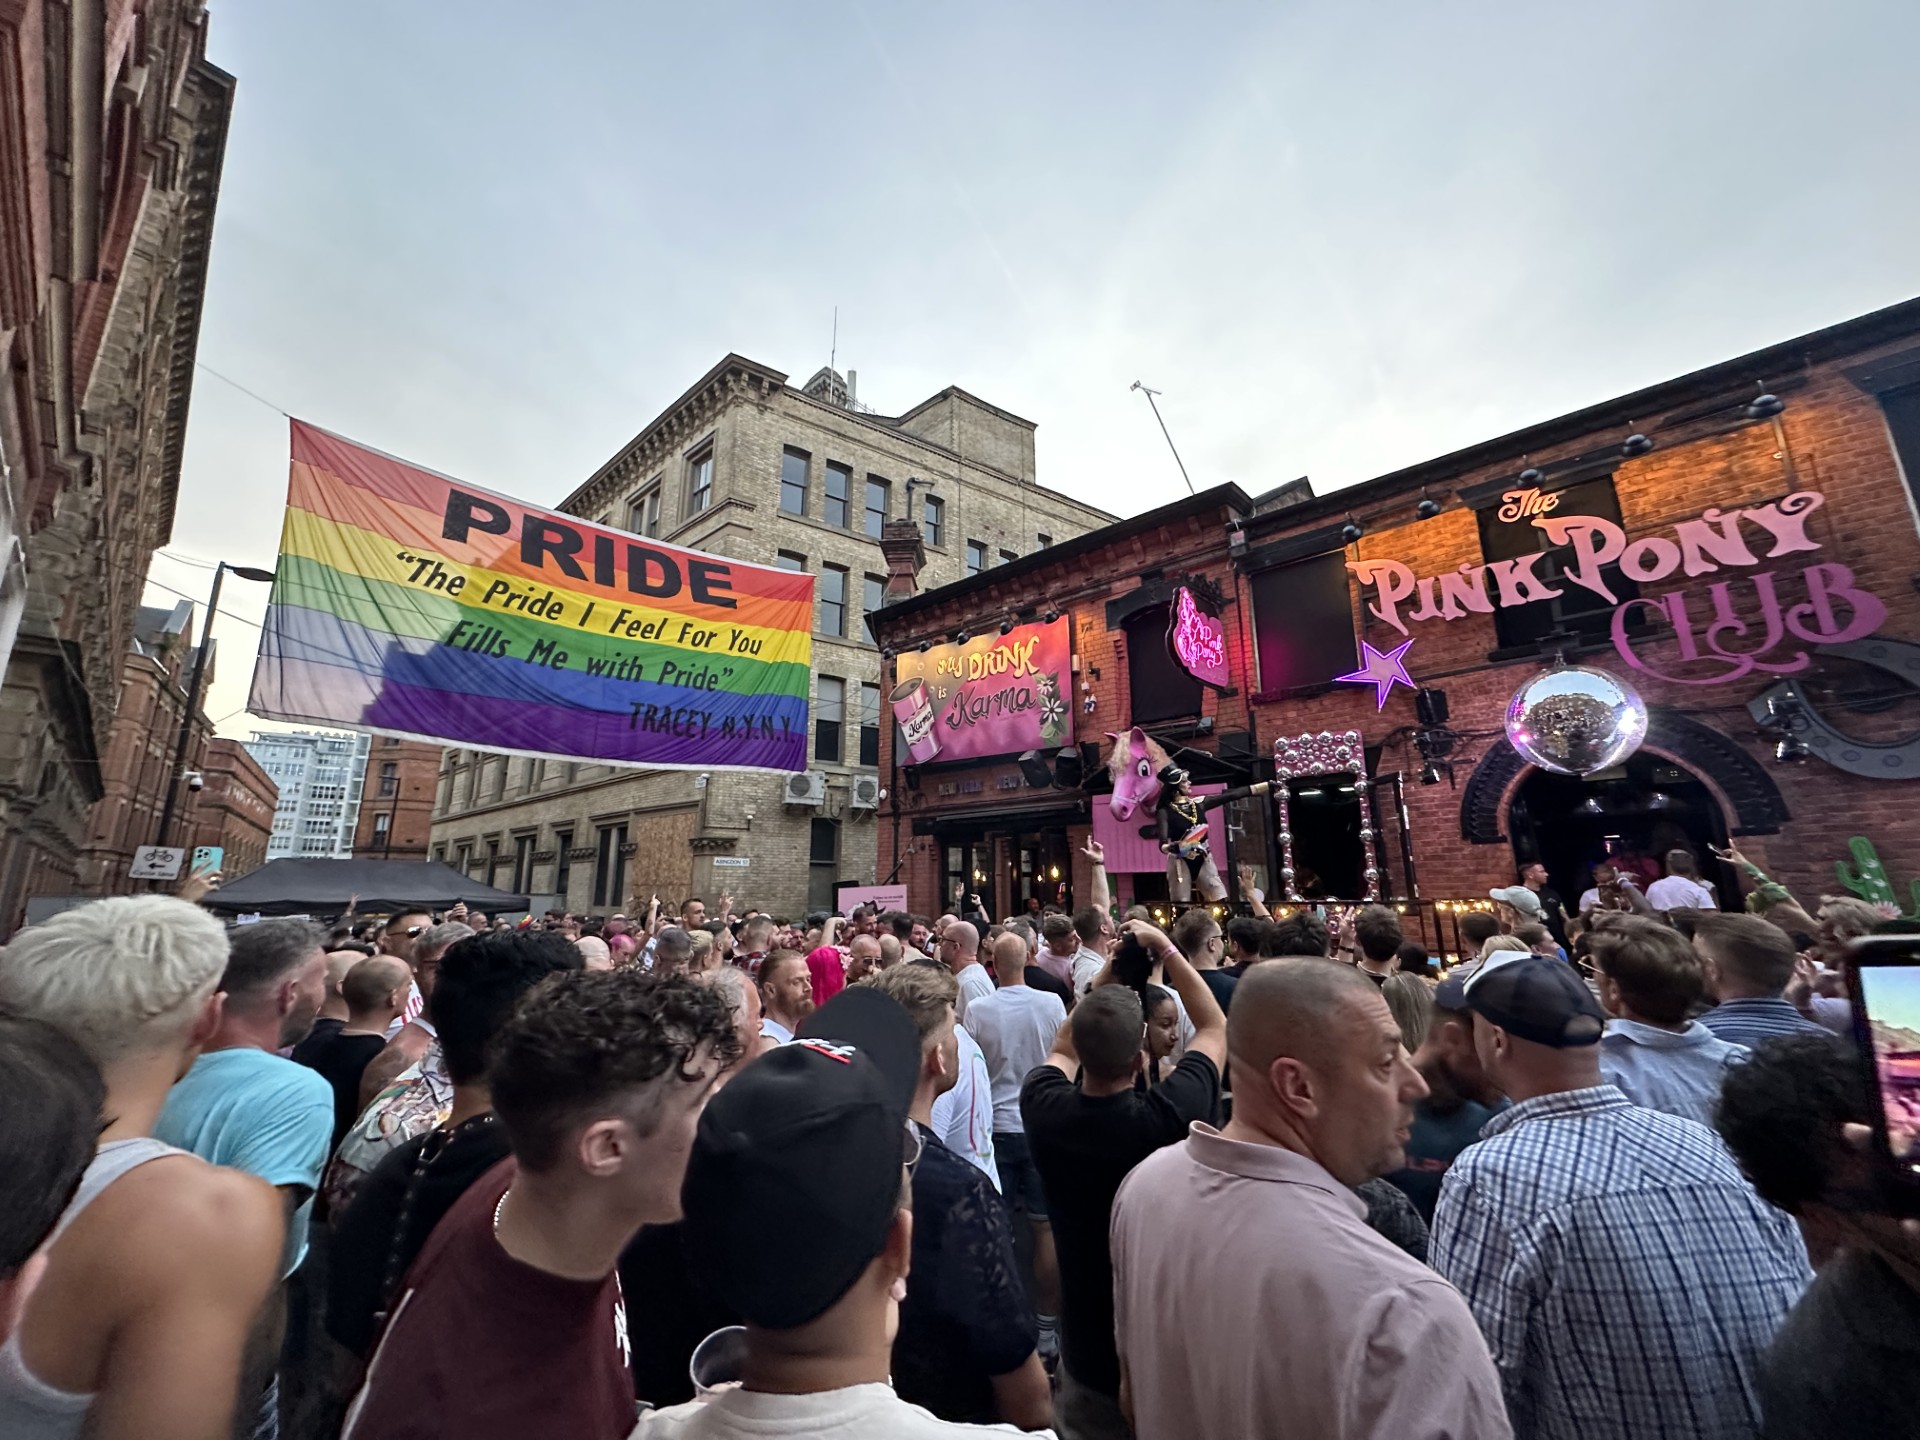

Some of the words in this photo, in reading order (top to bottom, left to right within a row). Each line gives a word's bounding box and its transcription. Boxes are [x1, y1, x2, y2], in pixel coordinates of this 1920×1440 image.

[1497, 487, 1559, 523] The
[441, 488, 738, 610] PRIDE
[1344, 551, 1565, 637] PINK
[1530, 490, 1826, 606] PONY
[396, 551, 467, 597] “The
[481, 579, 565, 621] Pride
[578, 602, 596, 627] I
[608, 608, 669, 641] Feel
[676, 622, 719, 649] For
[728, 628, 764, 656] You
[1610, 562, 1889, 686] CLUB
[443, 619, 512, 659] Fills
[524, 637, 570, 671] Me
[585, 651, 644, 683] with
[656, 660, 735, 692] Pride”
[629, 701, 713, 741] TRACEY
[720, 713, 797, 744] N.Y.N.Y.
[908, 710, 933, 738] Karma
[937, 685, 947, 700] is
[945, 686, 1037, 731] Karma
